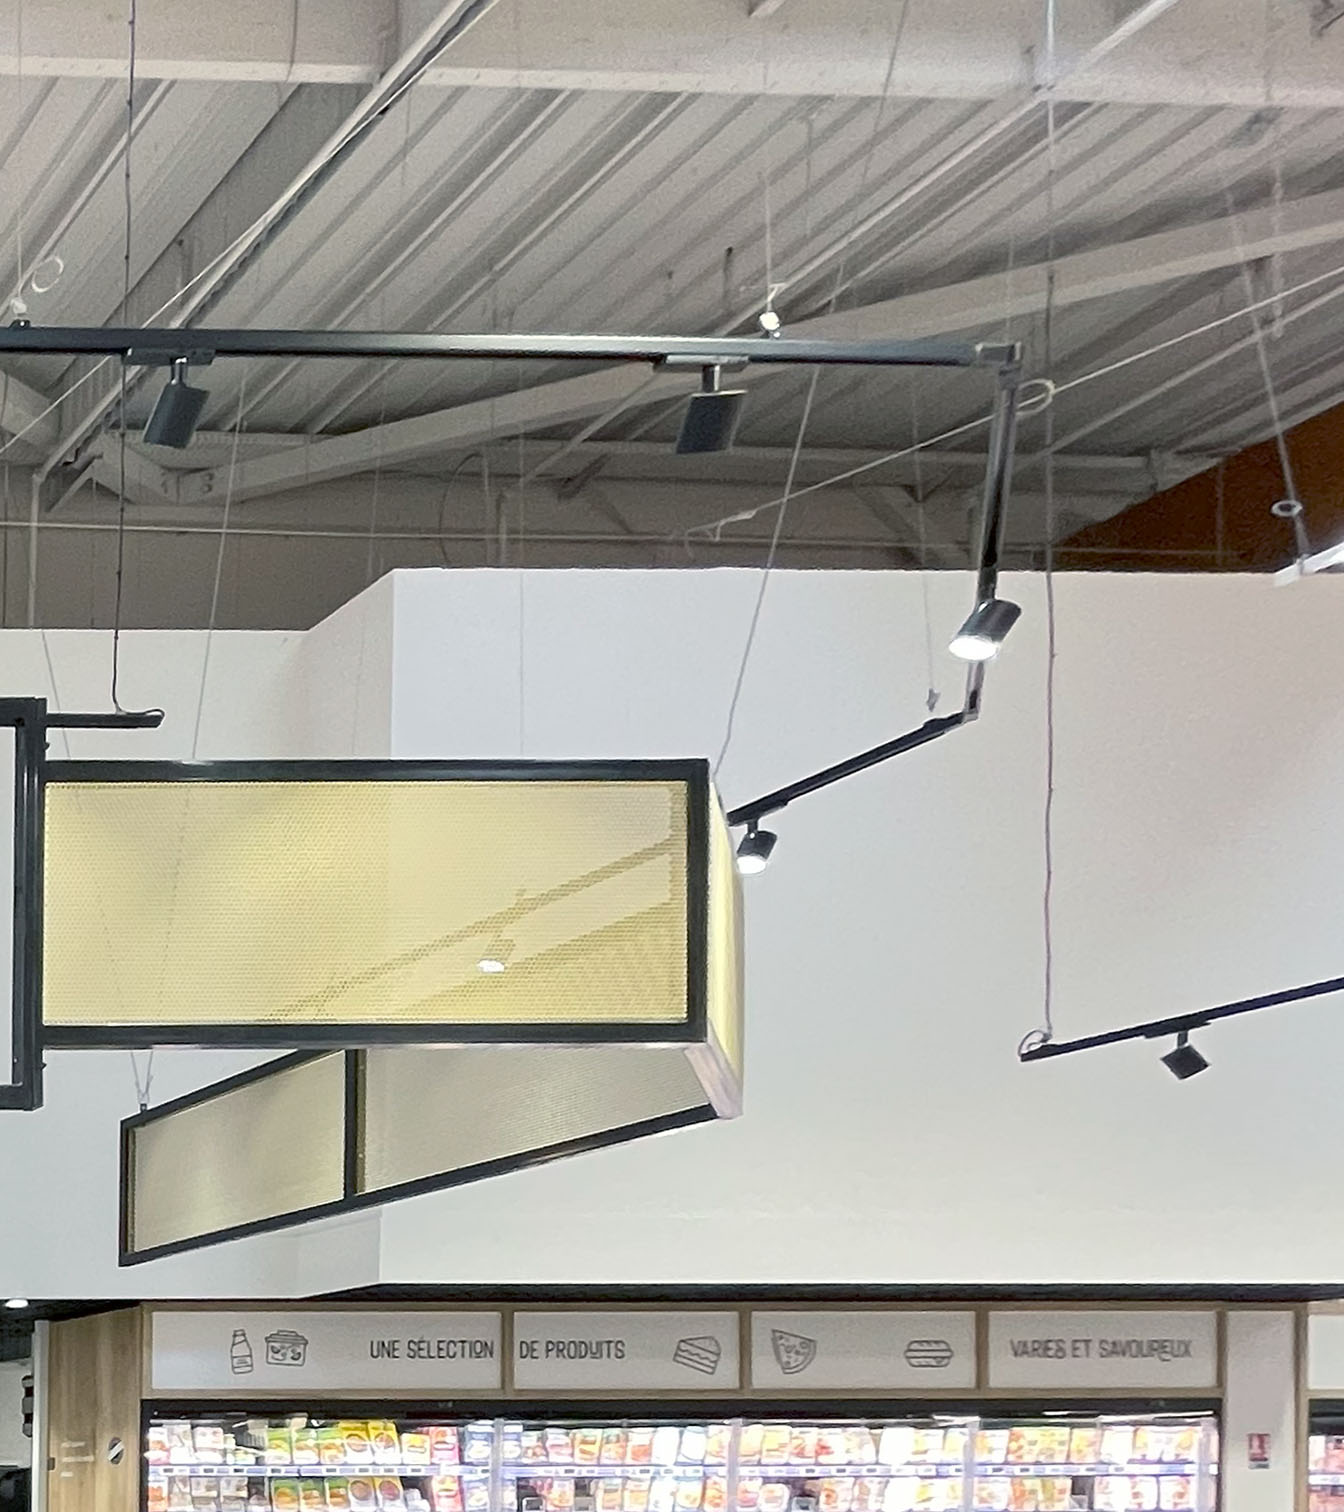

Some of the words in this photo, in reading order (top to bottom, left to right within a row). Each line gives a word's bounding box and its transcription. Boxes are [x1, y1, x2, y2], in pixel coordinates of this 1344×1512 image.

[369, 1340, 401, 1359] UNE
[406, 1336, 494, 1359] SÉLECTION
[519, 1340, 539, 1359] DE
[545, 1340, 626, 1360] PRODUITS
[1071, 1339, 1092, 1358] ET
[1099, 1339, 1192, 1362] SAVOUREUX
